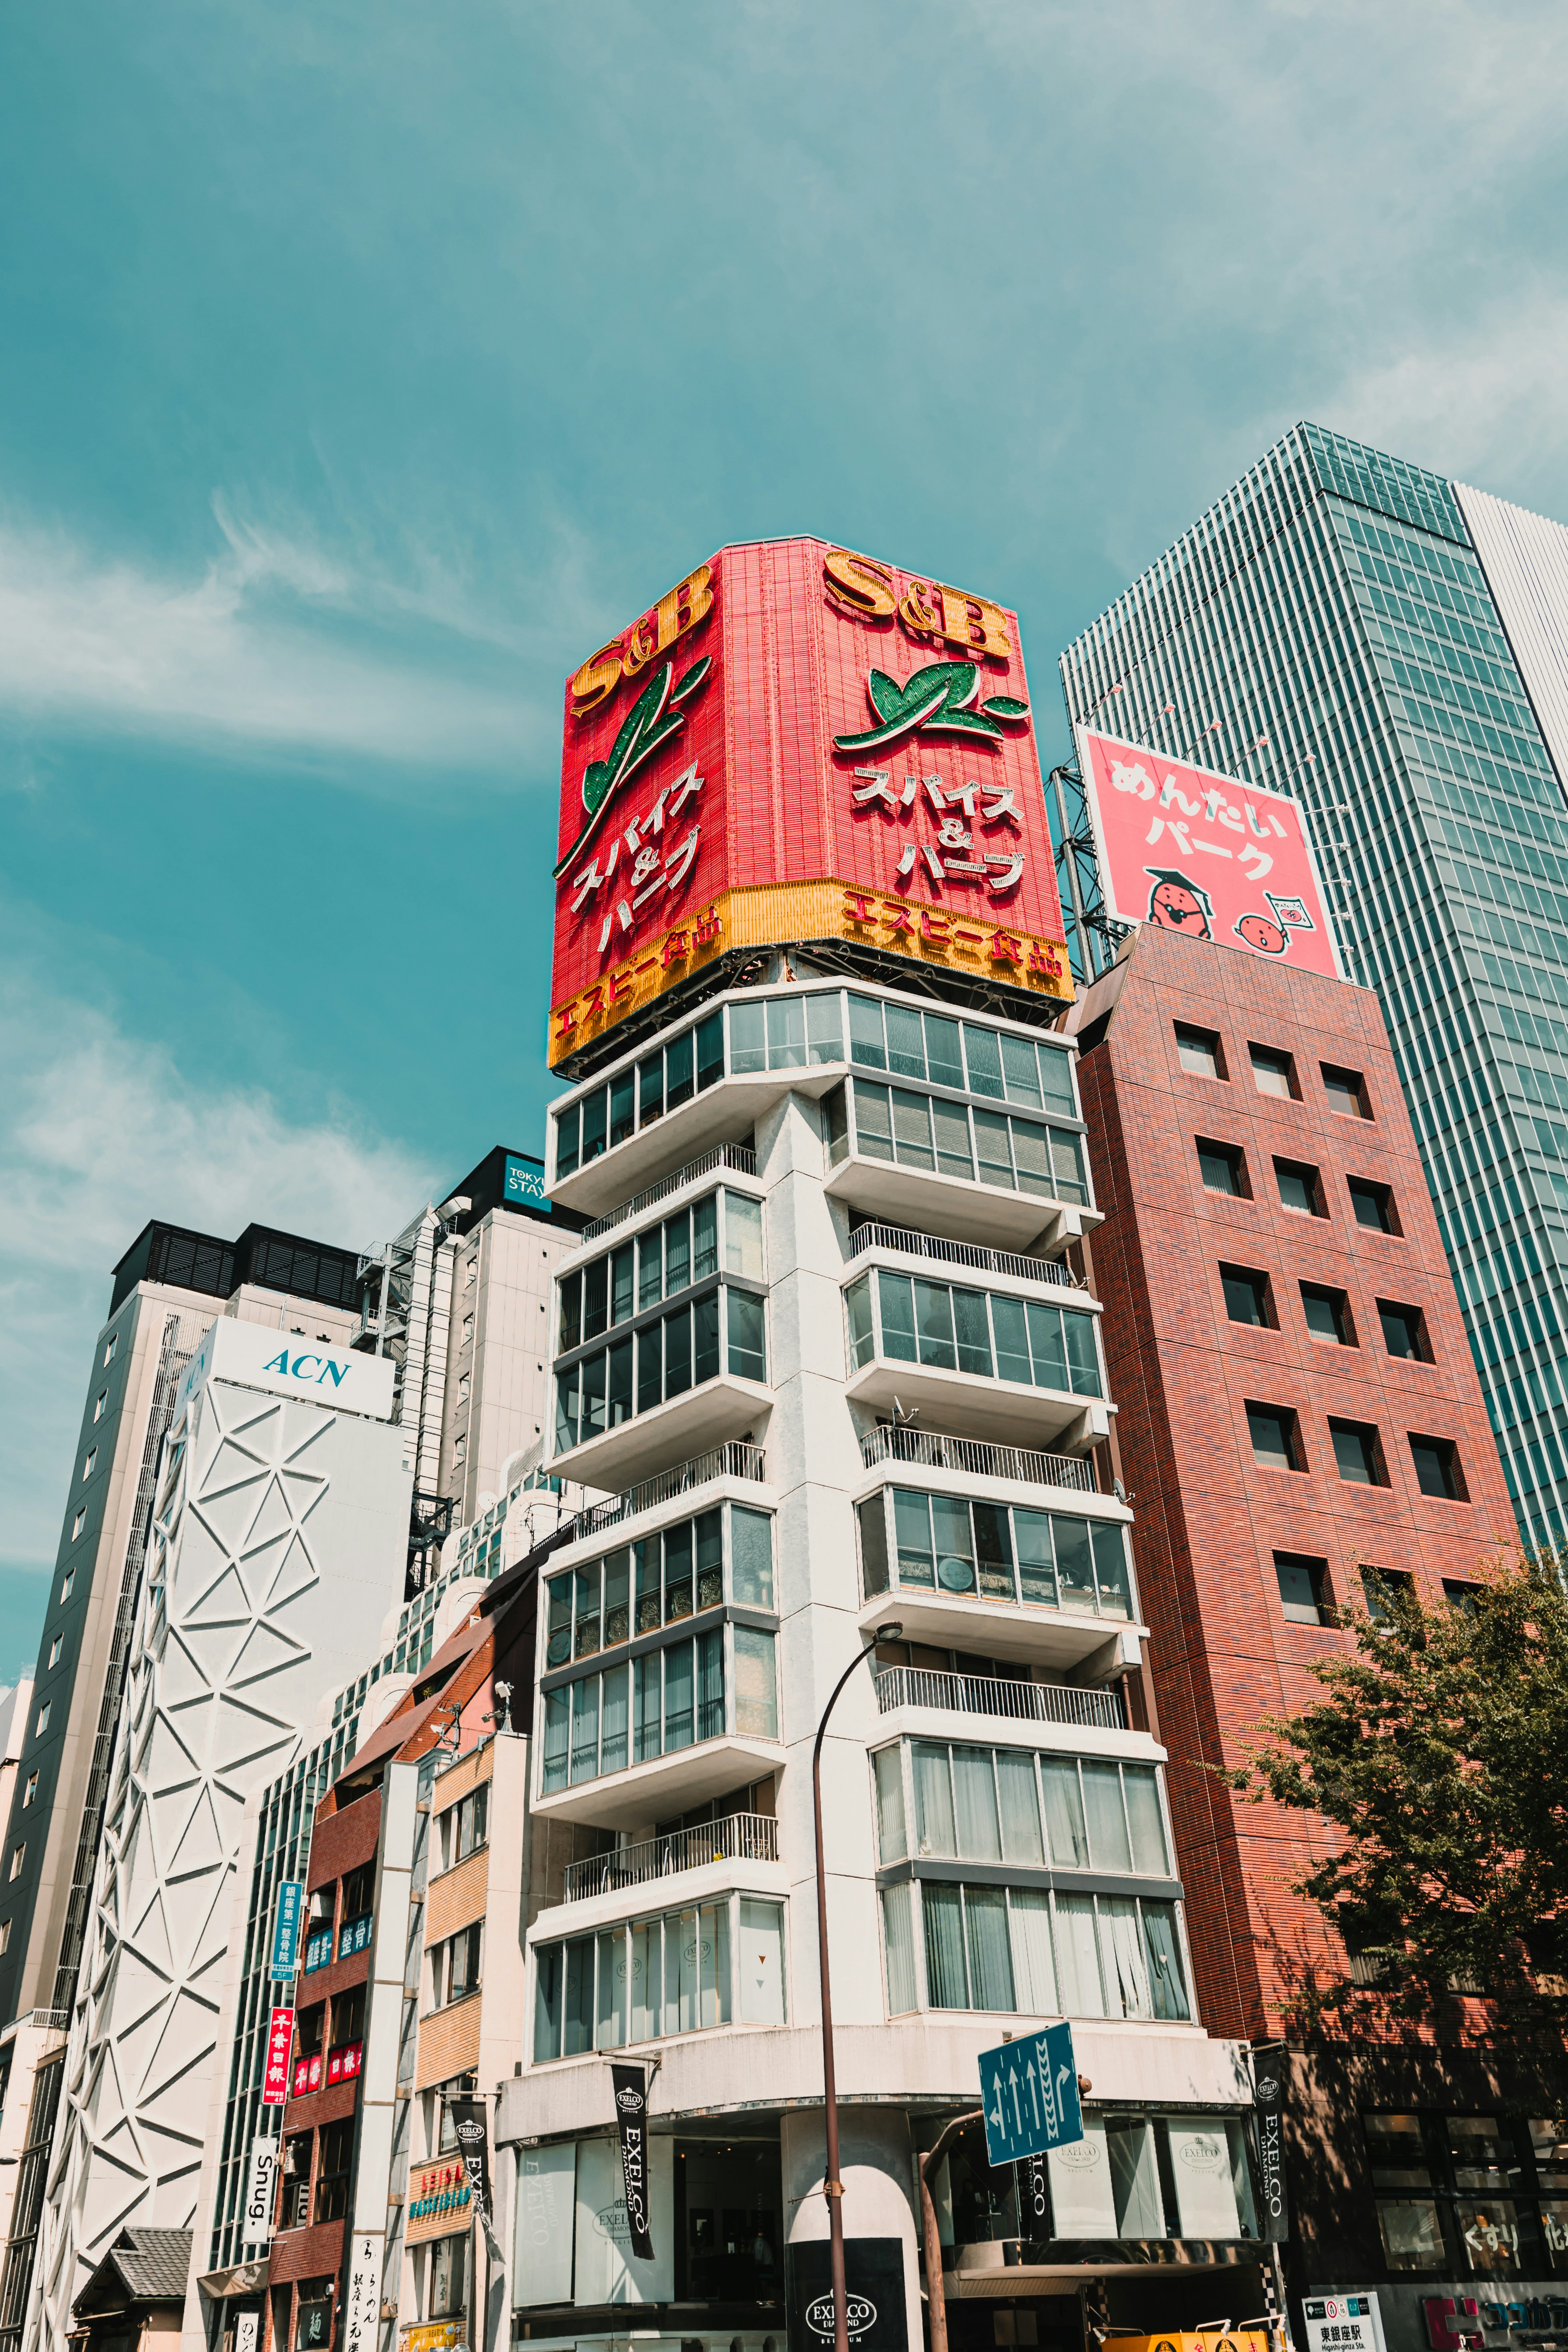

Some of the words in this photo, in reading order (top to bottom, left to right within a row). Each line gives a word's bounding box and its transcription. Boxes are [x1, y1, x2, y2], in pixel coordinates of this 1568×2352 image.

[824, 550, 1012, 658] S&B
[571, 564, 715, 718] S&B
[852, 766, 1024, 822] スパイス
[1111, 760, 1287, 838] めんたい
[570, 760, 705, 913] スパイス
[938, 818, 974, 850] &
[1145, 816, 1273, 880] パーク
[597, 824, 701, 953] ハーブ
[630, 846, 659, 886] &
[896, 845, 1026, 889] ハーブ
[844, 890, 1063, 978] エスビー食品
[554, 904, 723, 1041] エスビー食品
[262, 1349, 352, 1388] ACN
[278, 1886, 296, 1963] 銀座第一整骨院
[268, 2014, 291, 2083] 千葉日報
[295, 2061, 321, 2089] 千葉
[619, 2095, 641, 2103] EXELCO
[1260, 2083, 1277, 2093] EXELCO
[421, 2164, 461, 2191] LEICA
[621, 2145, 634, 2212] DIAMOND
[626, 2126, 645, 2233] EXELCO
[1061, 2147, 1096, 2156] EXELCO
[1185, 2149, 1218, 2157] EXELCO
[1261, 2135, 1269, 2200] DIAMOND
[1266, 2114, 1281, 2217] EXELCO
[249, 2155, 273, 2226] Snug.
[409, 2187, 471, 2219] HASSELBLAD
[1465, 2224, 1518, 2251] くすり
[1320, 2325, 1362, 2342] 東銀座駅
[1322, 2343, 1355, 2352] Higashi-ginza
